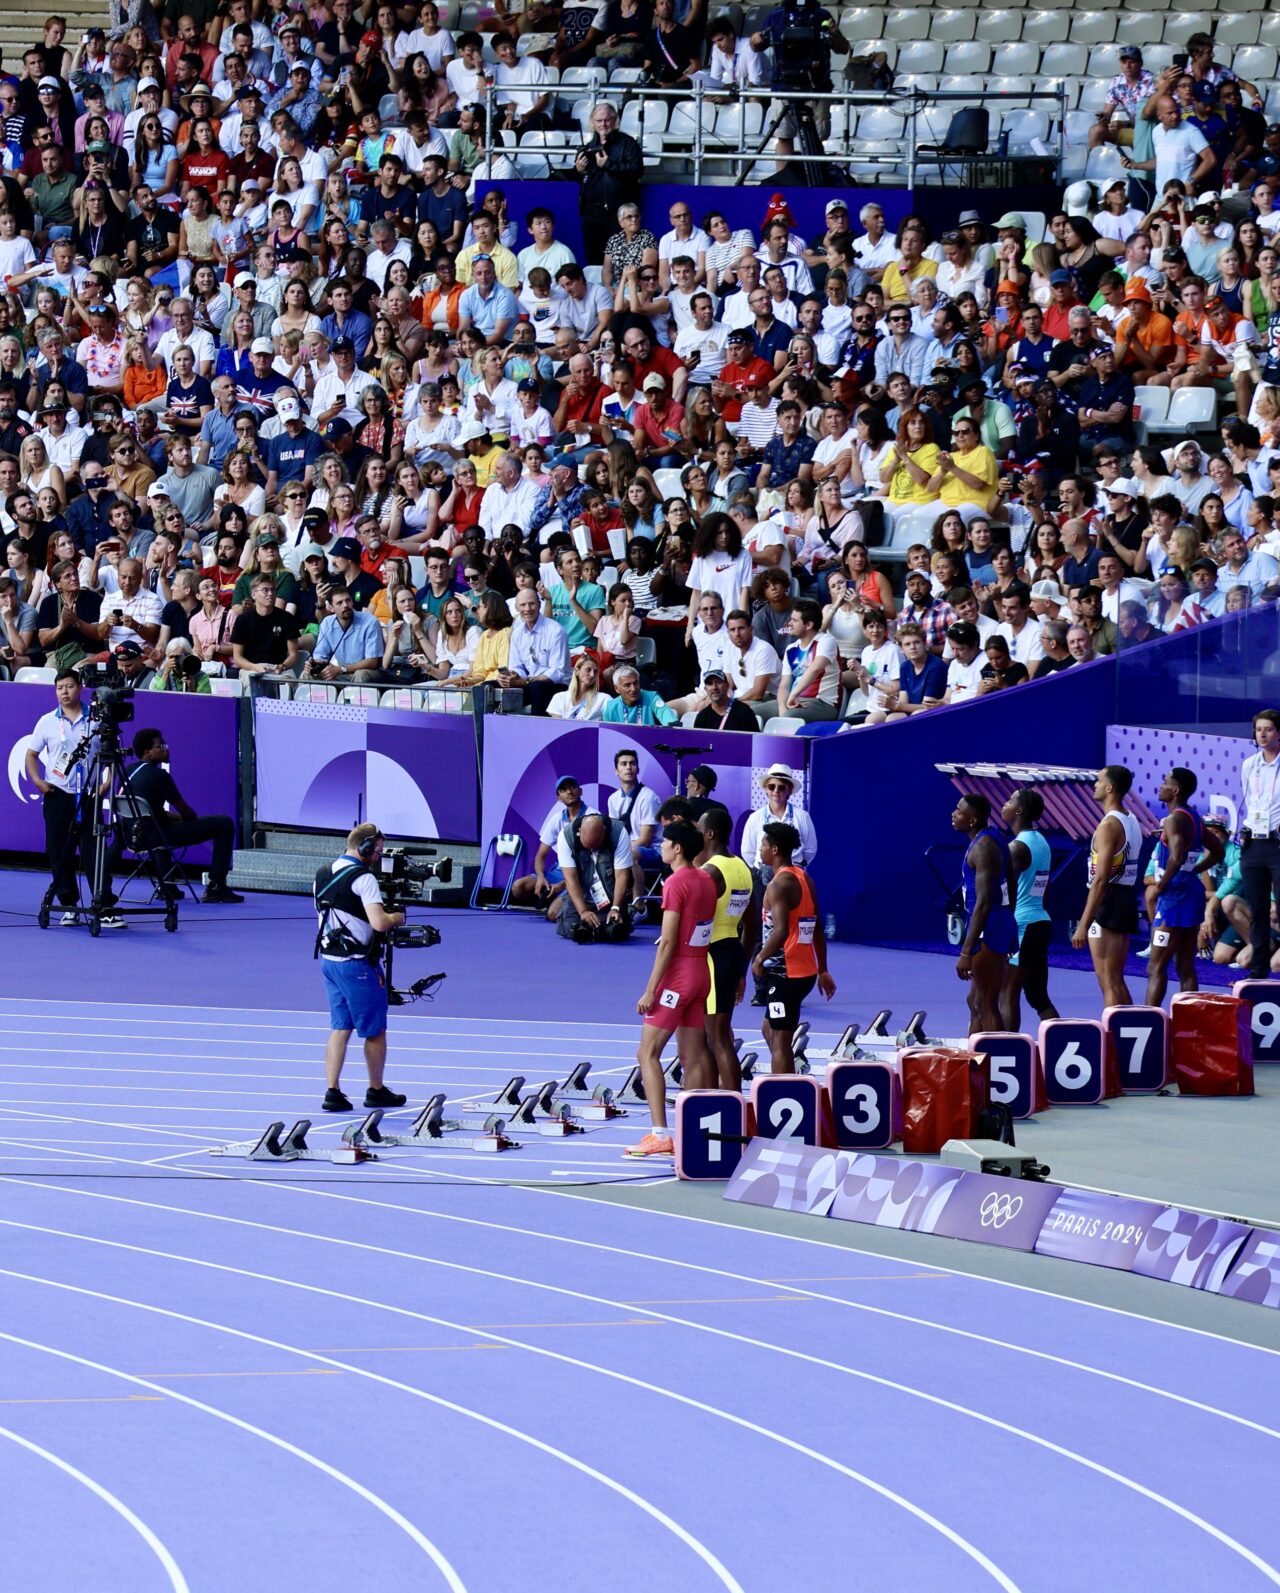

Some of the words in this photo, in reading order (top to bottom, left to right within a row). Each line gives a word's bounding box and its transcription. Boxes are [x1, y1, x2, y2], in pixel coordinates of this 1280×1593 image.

[279, 450, 294, 461] USA
[1091, 926, 1097, 935] 8
[1158, 934, 1165, 943] 9
[665, 993, 674, 1005] 2
[773, 1005, 781, 1015] 4
[1251, 1001, 1280, 1048] 9
[1054, 1041, 1093, 1090] 6
[1120, 1027, 1153, 1074] 7
[990, 1056, 1020, 1104] 5
[769, 1097, 805, 1145] 2
[842, 1083, 881, 1134] 3
[699, 1111, 722, 1162] 1
[1052, 1211, 1101, 1238] PARIS
[1100, 1221, 1144, 1246] 2024
